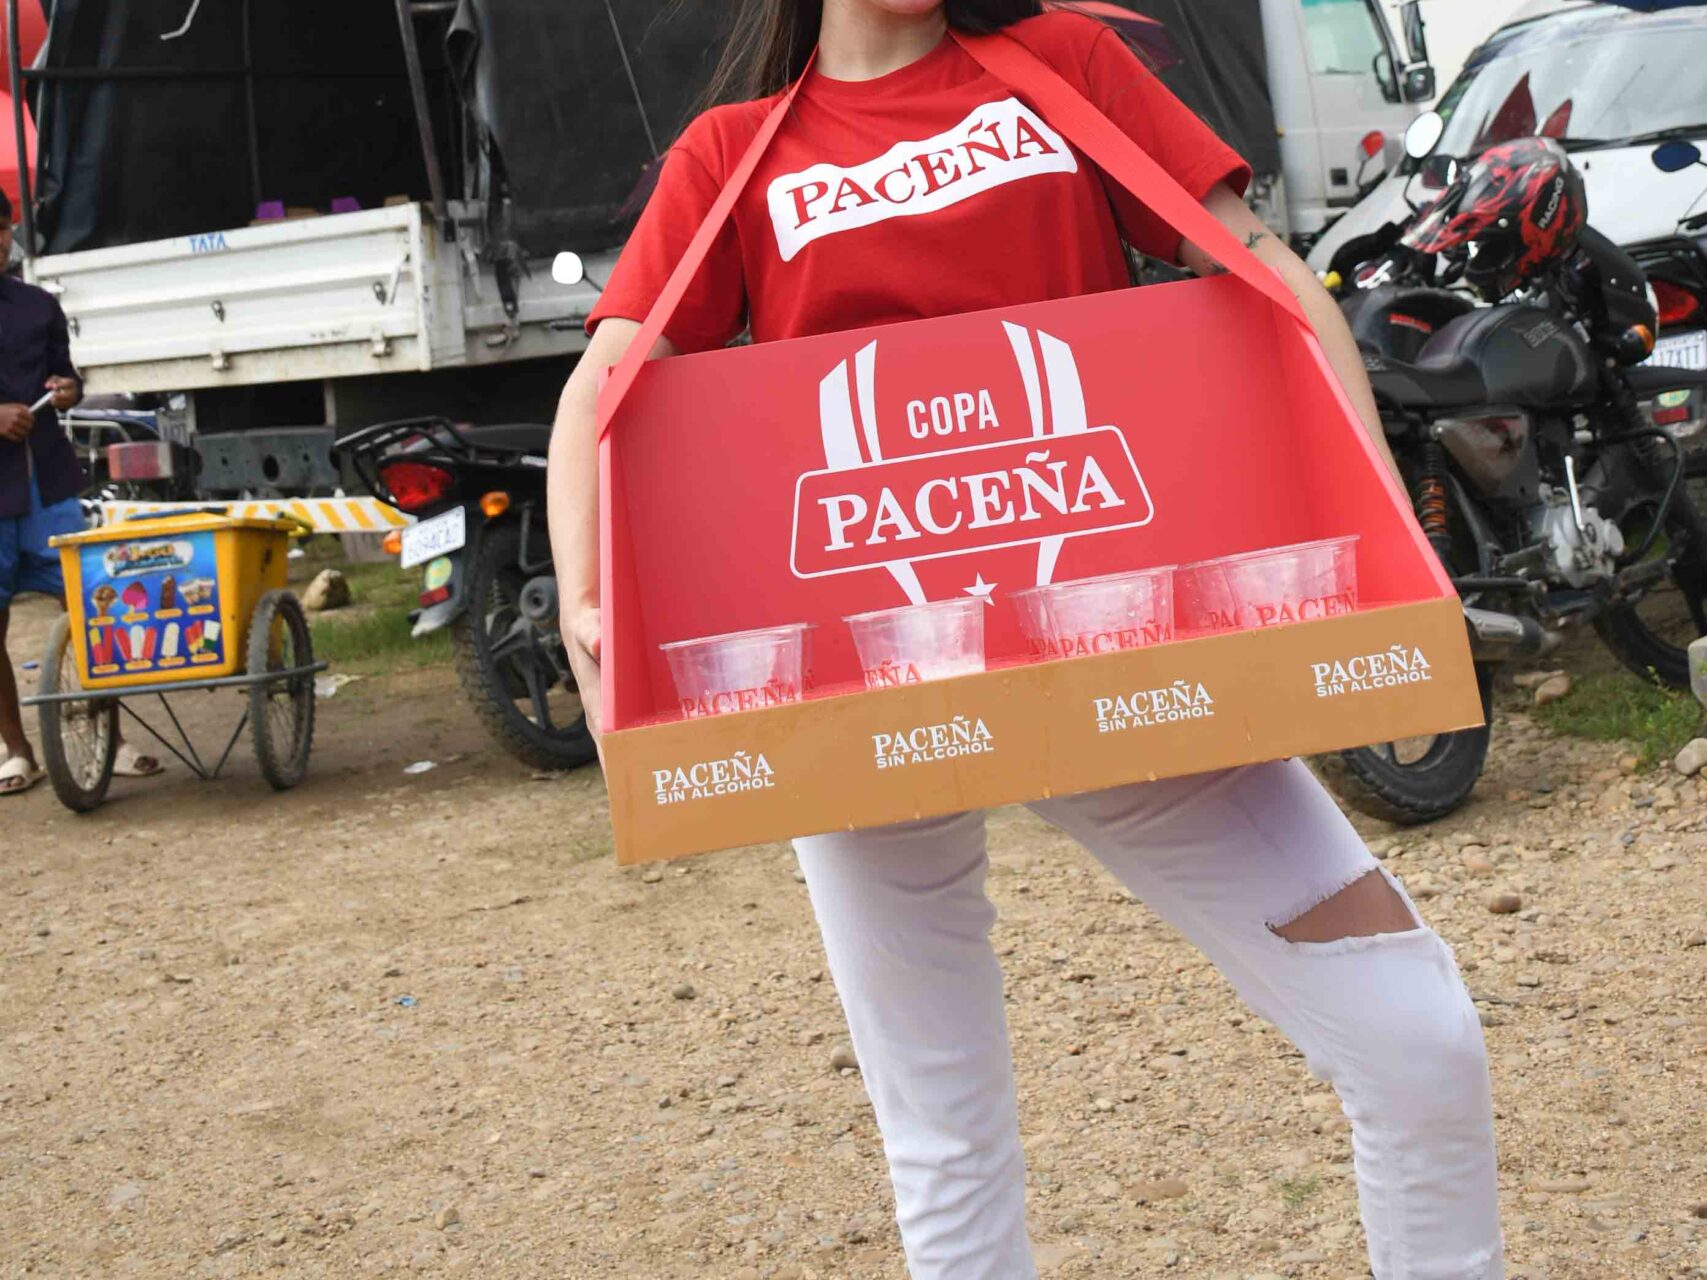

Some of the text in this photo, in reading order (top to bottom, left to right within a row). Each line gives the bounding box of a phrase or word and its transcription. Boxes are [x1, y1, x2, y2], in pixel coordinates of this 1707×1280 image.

[785, 115, 1058, 231] PACEÑA
[1537, 176, 1564, 229] RACING
[188, 231, 227, 252] TATA
[906, 389, 1000, 439] COPA
[817, 449, 1125, 551] PACEÑA
[1310, 644, 1431, 686] PACEÑA
[1316, 670, 1432, 697] SIN ALCOHOL
[1093, 680, 1214, 722] PACEÑA
[1098, 705, 1215, 733] SIN ALCOHOL
[872, 715, 994, 758] PACEÑA
[876, 741, 994, 769] SIN ALCOHOL
[652, 750, 775, 793] PACEÑA
[656, 777, 775, 805] SIN ALCOHOL
